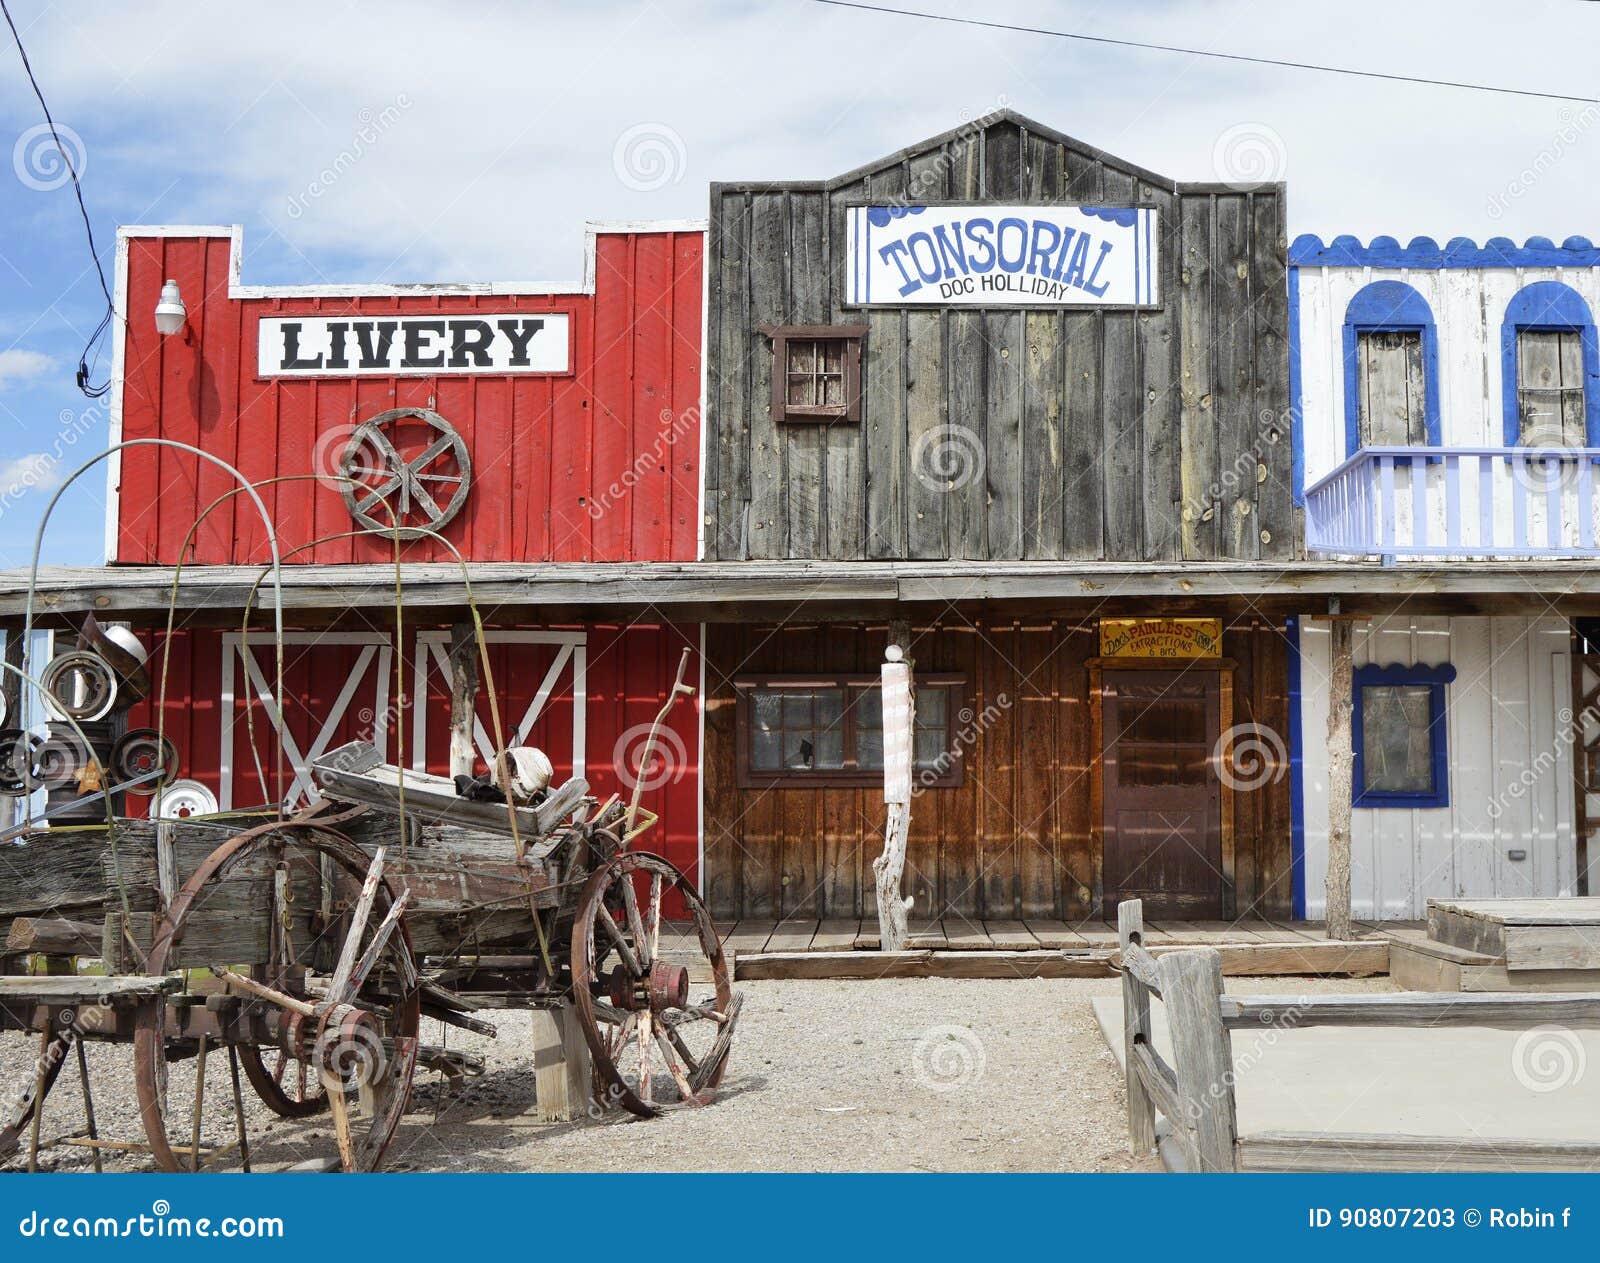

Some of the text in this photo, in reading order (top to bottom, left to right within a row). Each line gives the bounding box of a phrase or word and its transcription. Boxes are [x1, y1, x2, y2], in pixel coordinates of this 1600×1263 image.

[878, 217, 1114, 298] TONSORIAL
[939, 274, 1069, 302] DOC HOLLIDAY
[280, 319, 545, 369] LIVERY
[1129, 621, 1194, 640] PAINLESS
[1130, 635, 1193, 653] EXTRACTIONS
[1160, 648, 1177, 656] BITS
